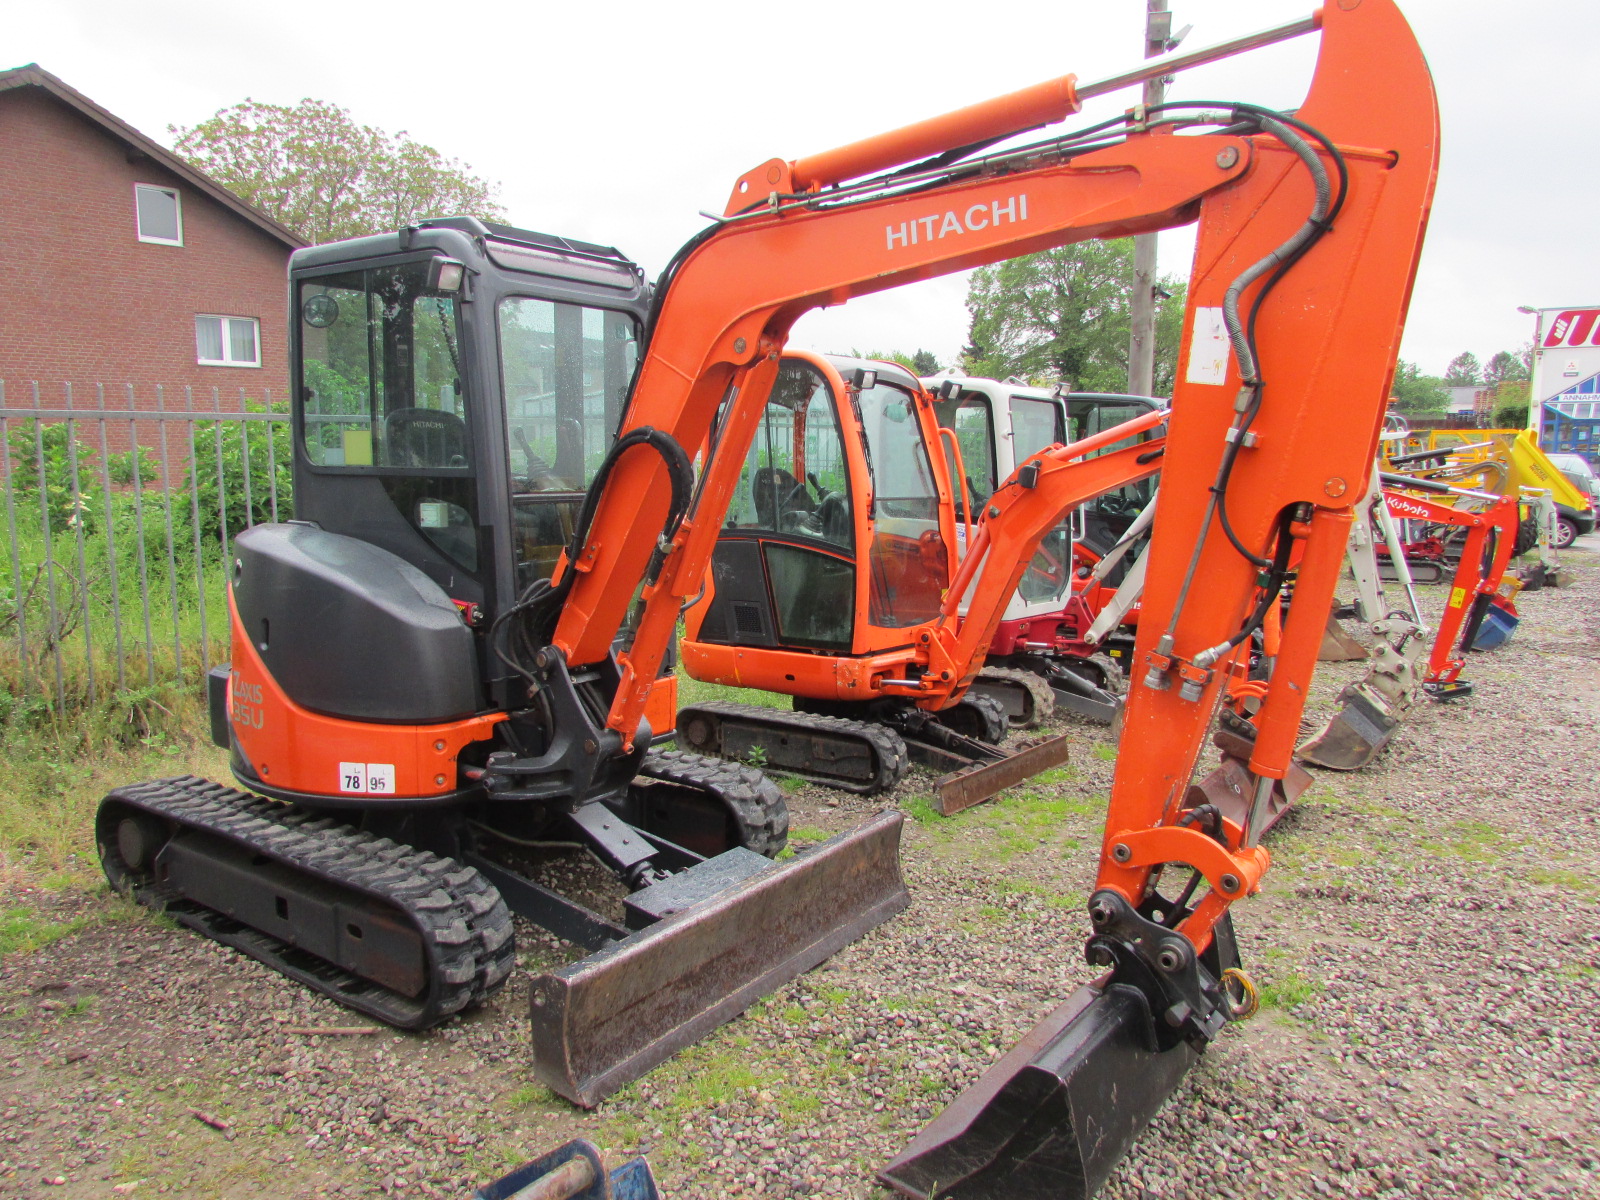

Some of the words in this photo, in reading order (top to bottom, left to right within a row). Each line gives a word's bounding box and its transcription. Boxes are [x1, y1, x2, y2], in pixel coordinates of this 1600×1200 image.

[885, 194, 1028, 251] HITACHI
[412, 420, 444, 429] HITACHI
[1387, 496, 1429, 518] Kubota
[233, 671, 263, 705] ZAXIS
[233, 700, 264, 730] 35U
[345, 775, 361, 789] 78
[369, 776, 386, 791] 95
